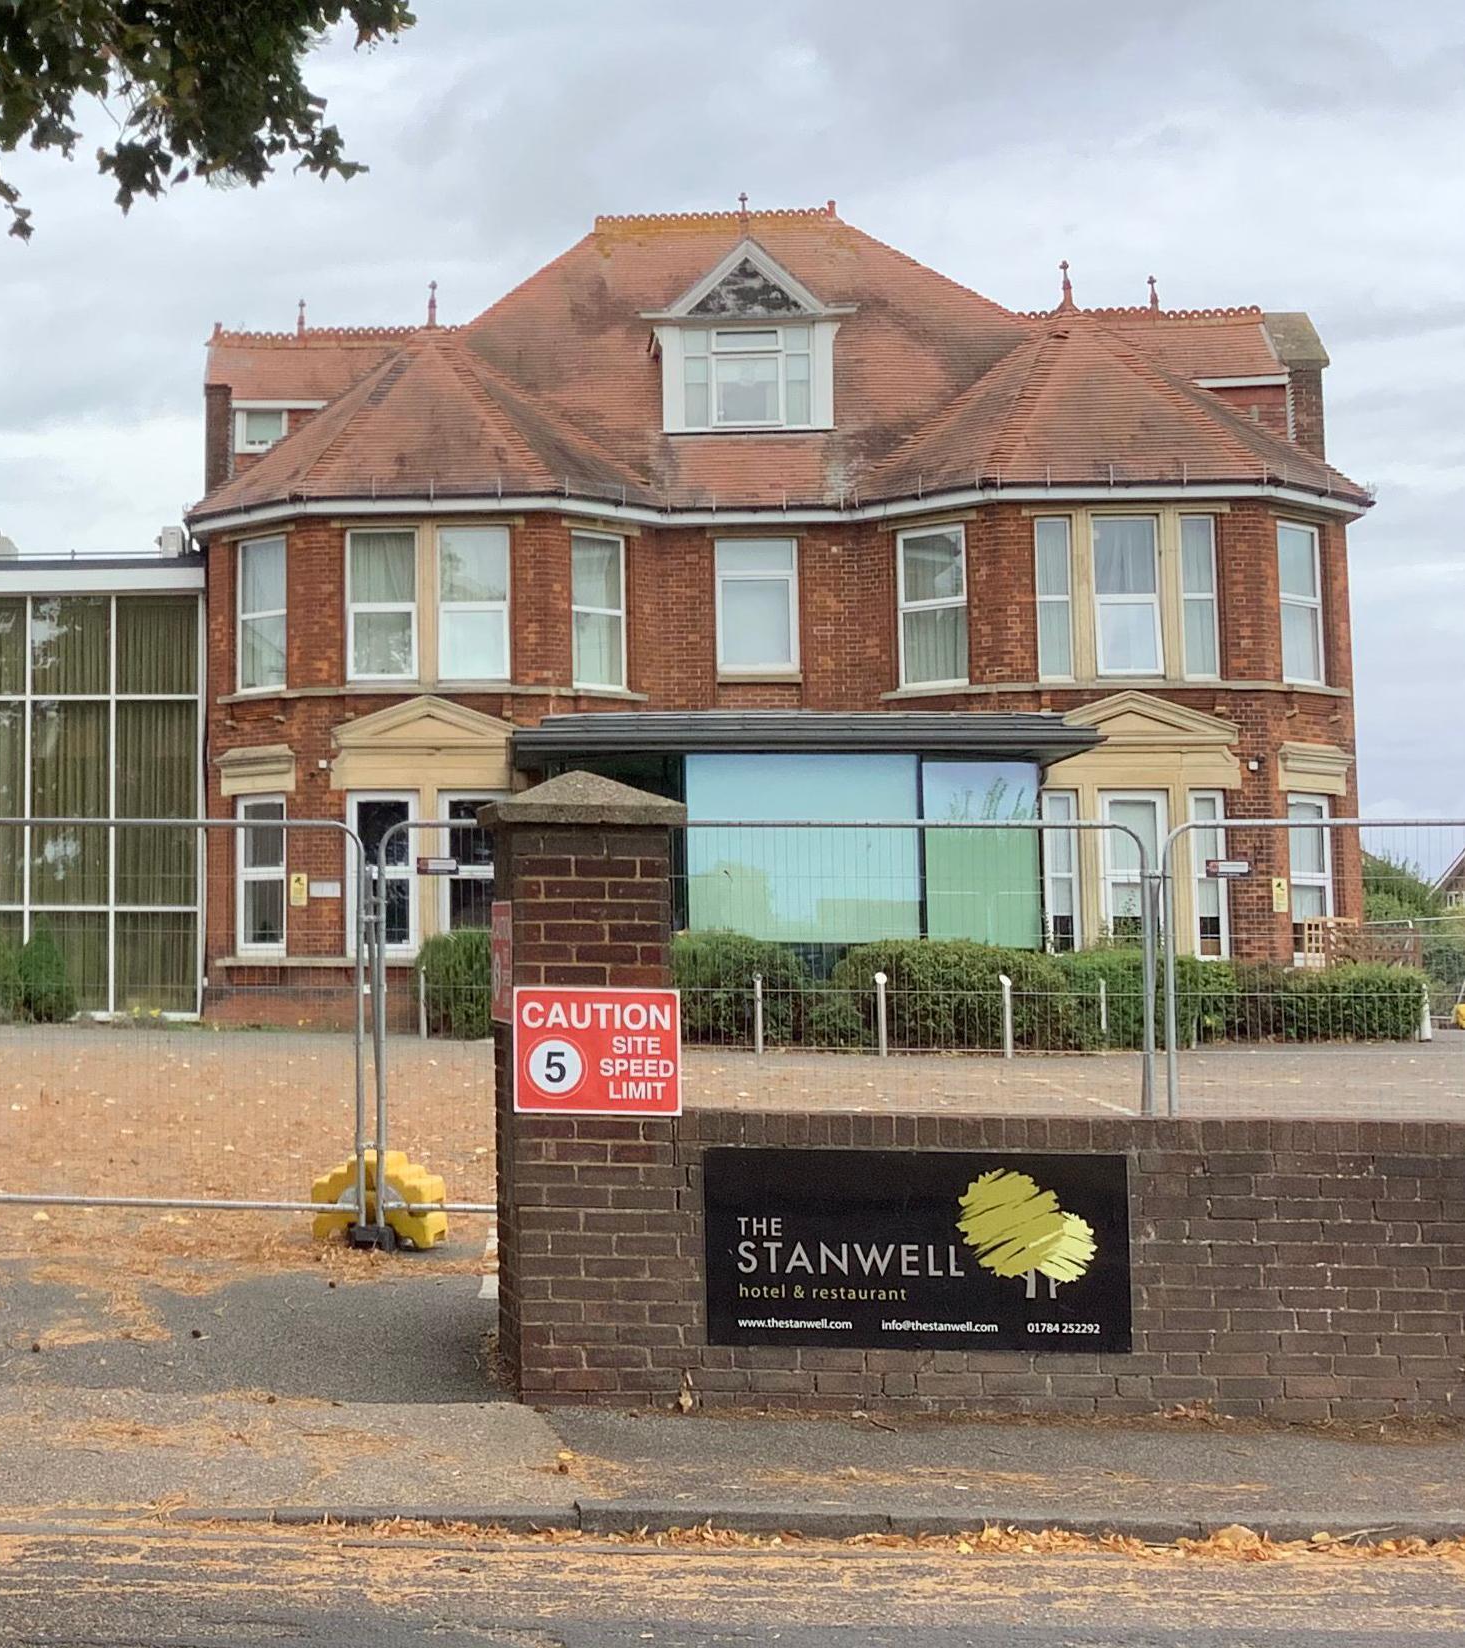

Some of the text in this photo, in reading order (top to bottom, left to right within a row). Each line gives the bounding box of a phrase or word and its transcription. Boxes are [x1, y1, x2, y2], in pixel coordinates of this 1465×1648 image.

[521, 1001, 671, 1031] CAUTION
[612, 1036, 661, 1055] SITE
[544, 1051, 567, 1083] 5
[599, 1058, 675, 1078] SPEED
[608, 1081, 666, 1101] LIMIT
[737, 1217, 783, 1237] THE
[737, 1241, 965, 1277] STANWELL
[739, 1284, 907, 1301] hotel & restaurant
[737, 1317, 853, 1330] www.thestanwell.com
[881, 1319, 999, 1333] info@thestanwell.com
[1027, 1322, 1101, 1334] 01784 252292
